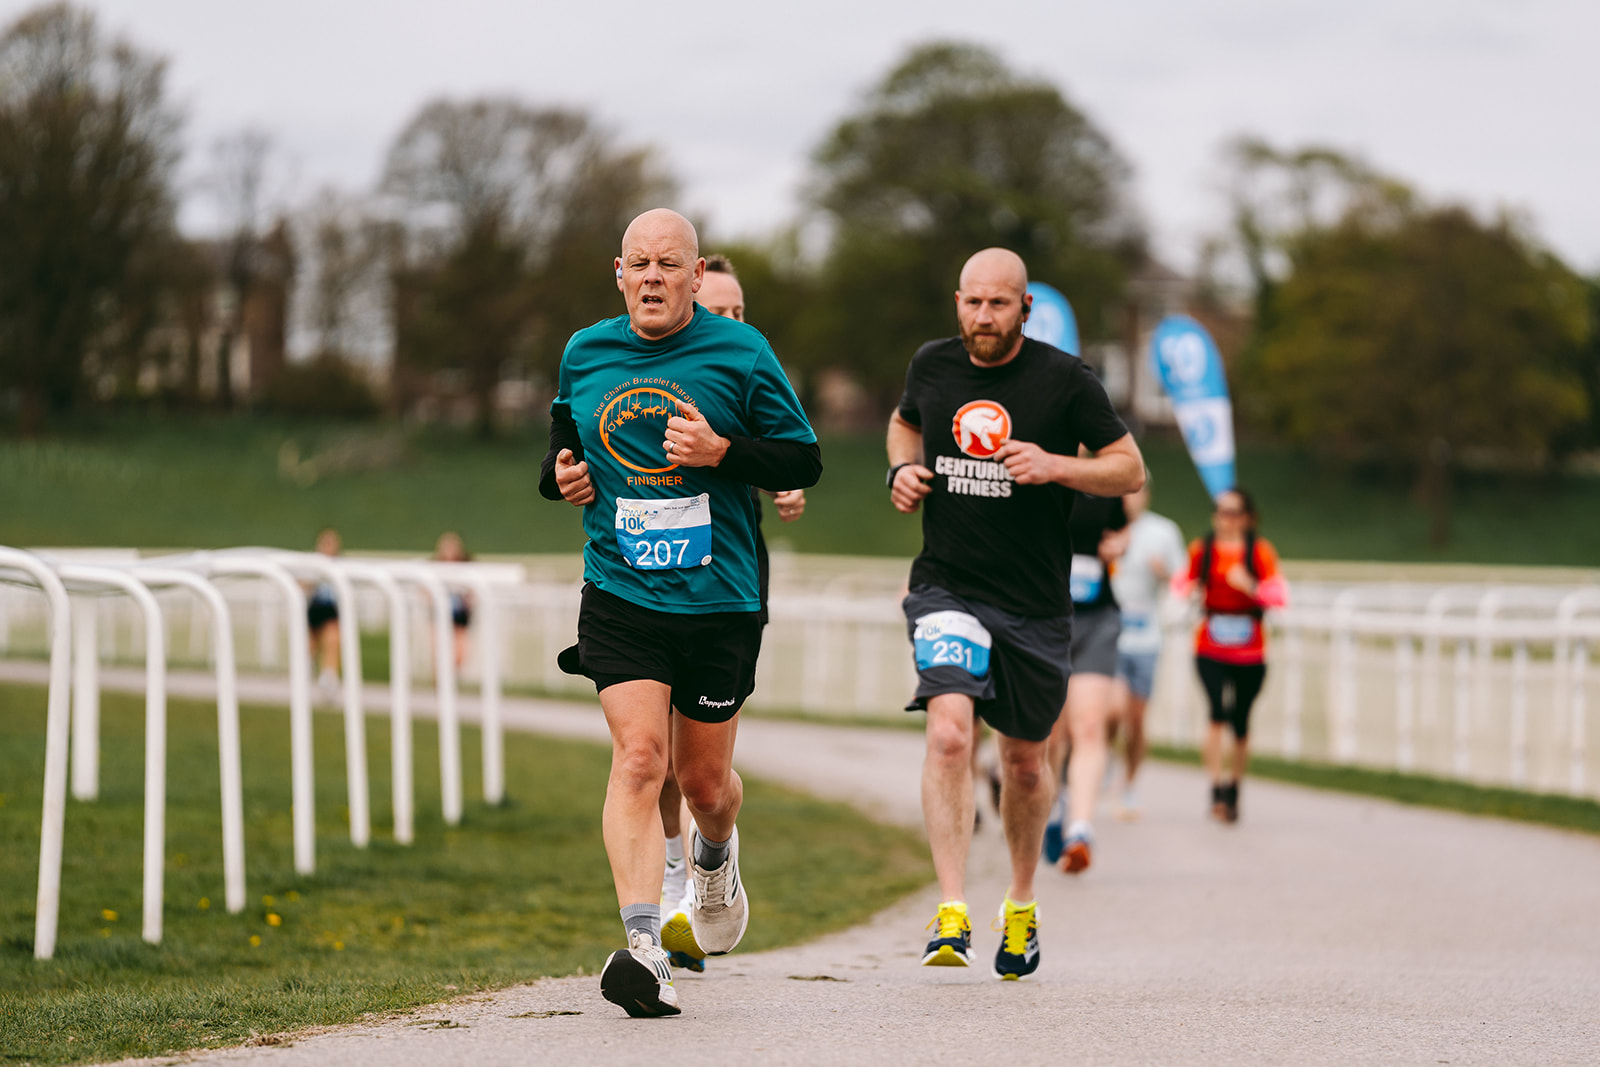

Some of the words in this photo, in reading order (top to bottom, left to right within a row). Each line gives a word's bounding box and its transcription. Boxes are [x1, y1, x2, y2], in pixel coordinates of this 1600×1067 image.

[593, 402, 605, 418] The
[604, 381, 631, 401] Charm
[633, 377, 670, 387] Bracelet
[627, 475, 683, 486] FINISHER
[947, 476, 1012, 498] FITNESS
[620, 516, 646, 531] 10k
[635, 539, 690, 566] 207
[932, 640, 973, 670] 231
